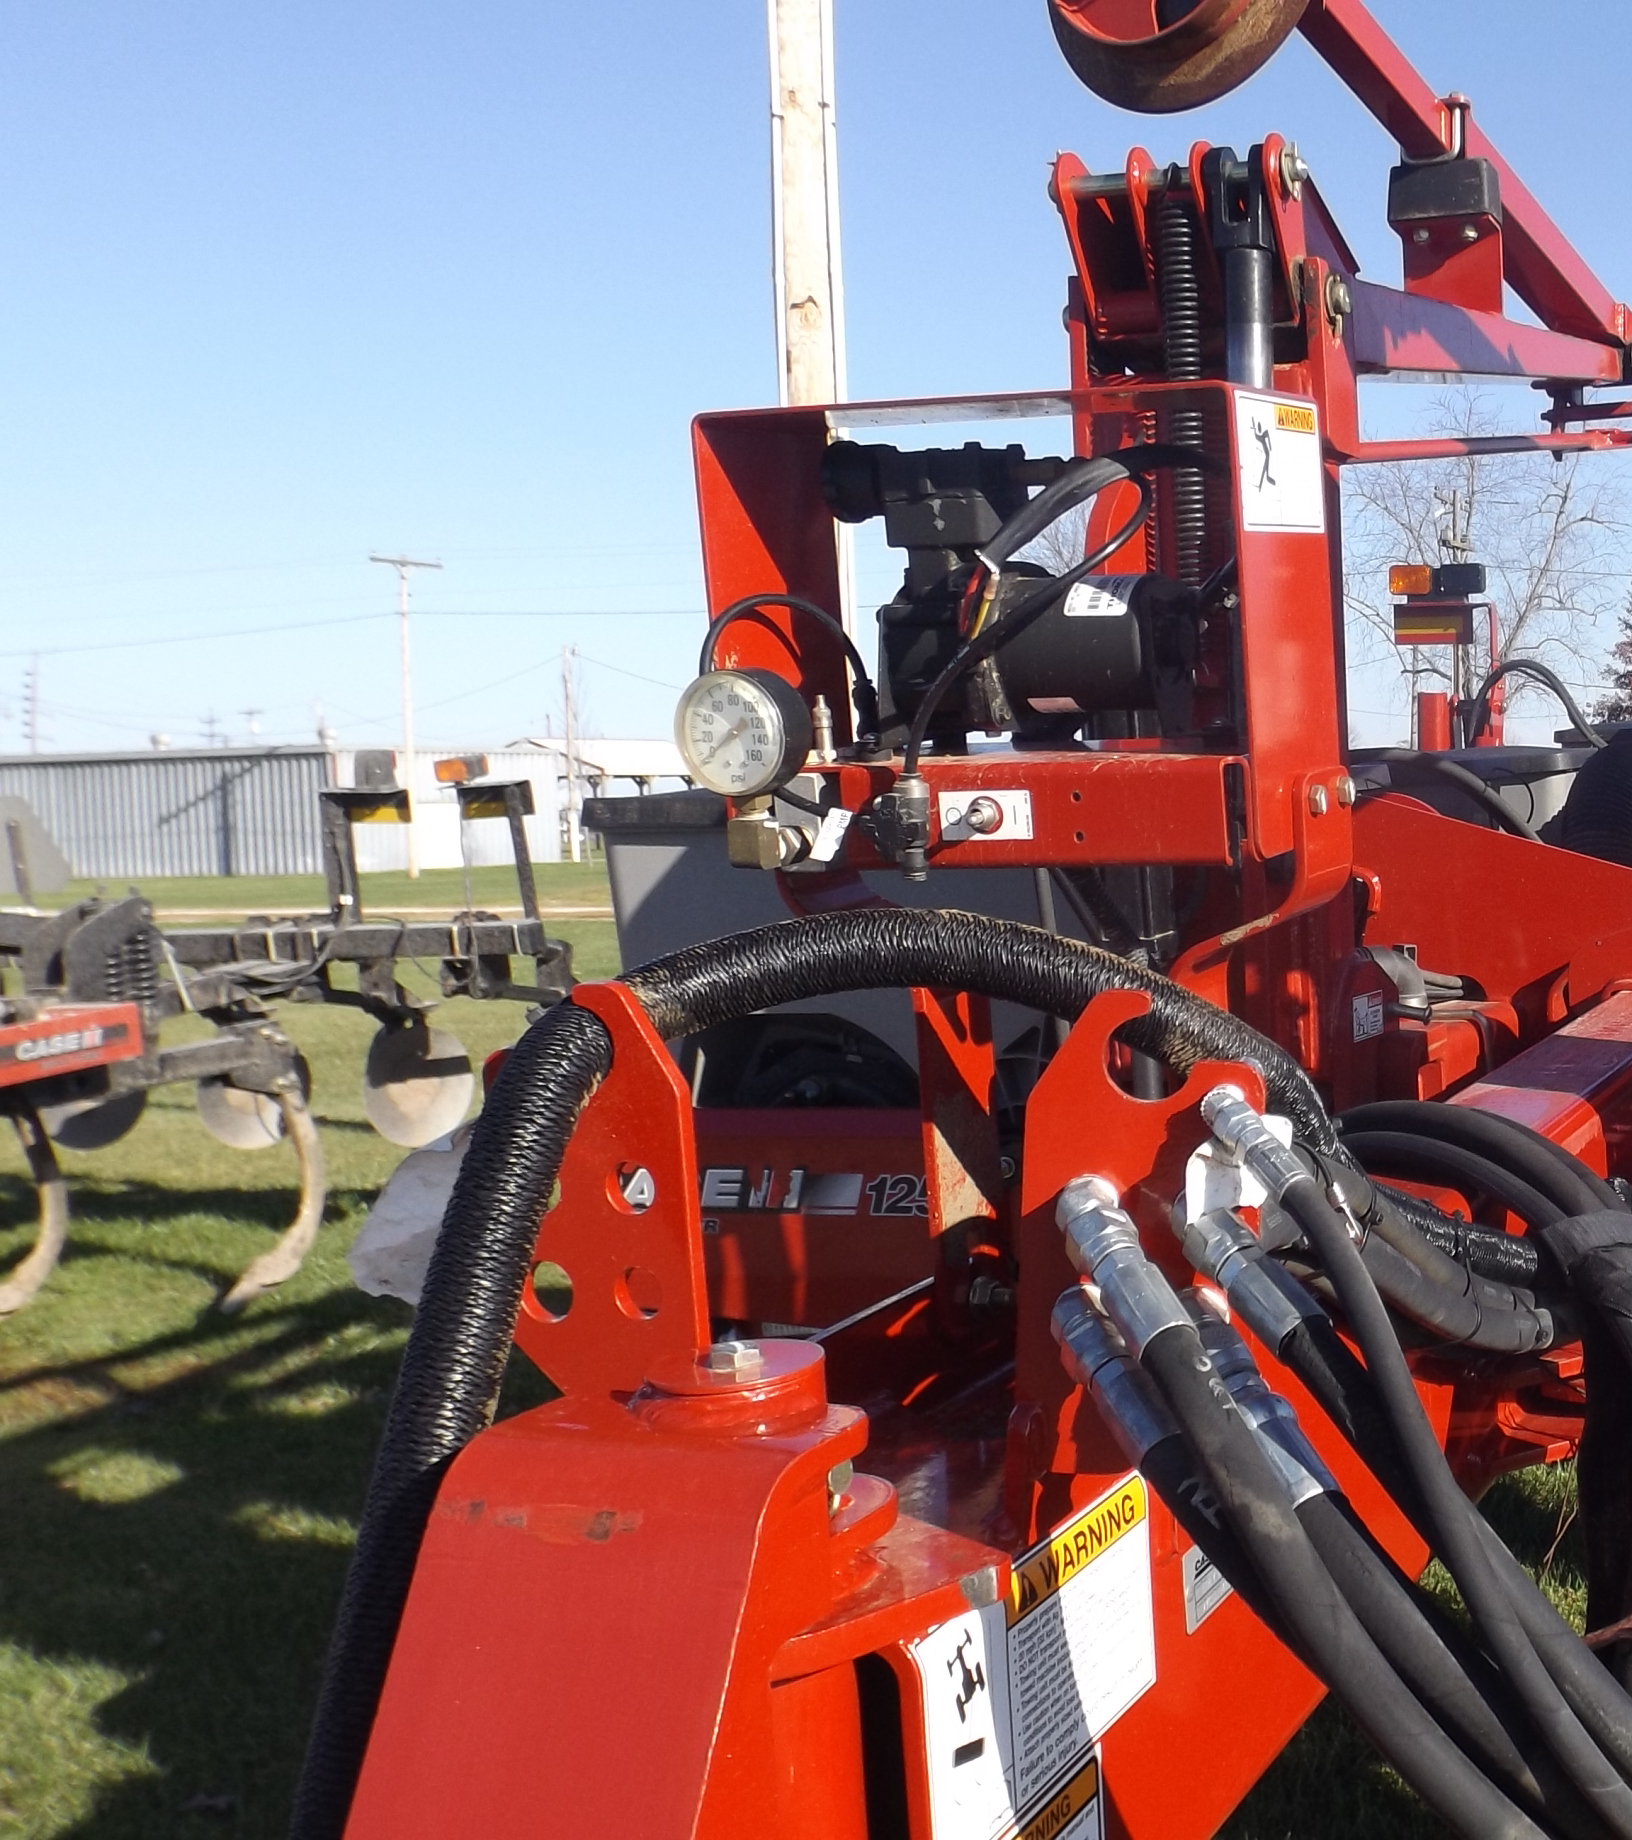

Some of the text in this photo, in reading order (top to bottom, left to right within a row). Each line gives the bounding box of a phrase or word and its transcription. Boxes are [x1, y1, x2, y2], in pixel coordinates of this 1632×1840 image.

[1283, 409, 1313, 431] WARNING
[728, 694, 739, 706] 80
[712, 701, 723, 713] 60
[743, 702, 759, 713] 100
[702, 714, 714, 725] 40
[750, 717, 765, 729] 120
[702, 731, 713, 743] 20
[752, 734, 769, 746] 140
[746, 750, 762, 762] 160
[731, 772, 746, 784] psi
[15, 1032, 80, 1061] CASE
[1039, 1494, 1135, 1590] WARNING
[1020, 1752, 1044, 1781] Failure
[1055, 1719, 1079, 1747] comply
[1031, 1758, 1056, 1788] serious
